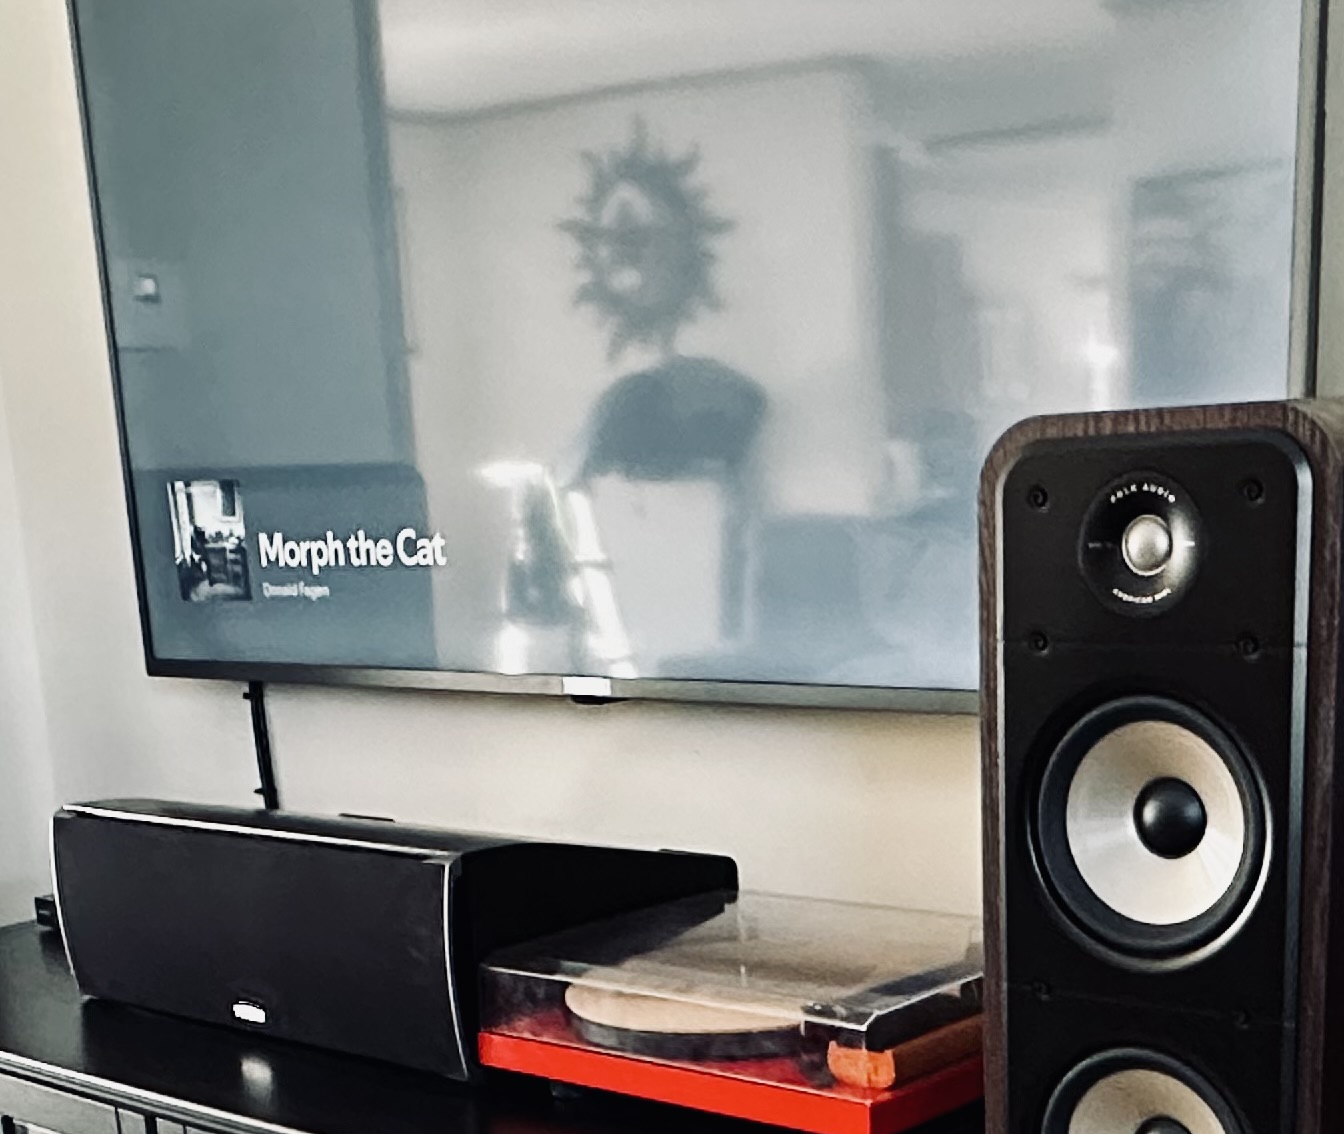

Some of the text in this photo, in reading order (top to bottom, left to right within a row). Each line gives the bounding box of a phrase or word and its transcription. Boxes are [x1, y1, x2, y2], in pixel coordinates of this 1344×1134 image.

[1142, 482, 1176, 503] AUDIO
[258, 528, 447, 575] Morph the Cat
